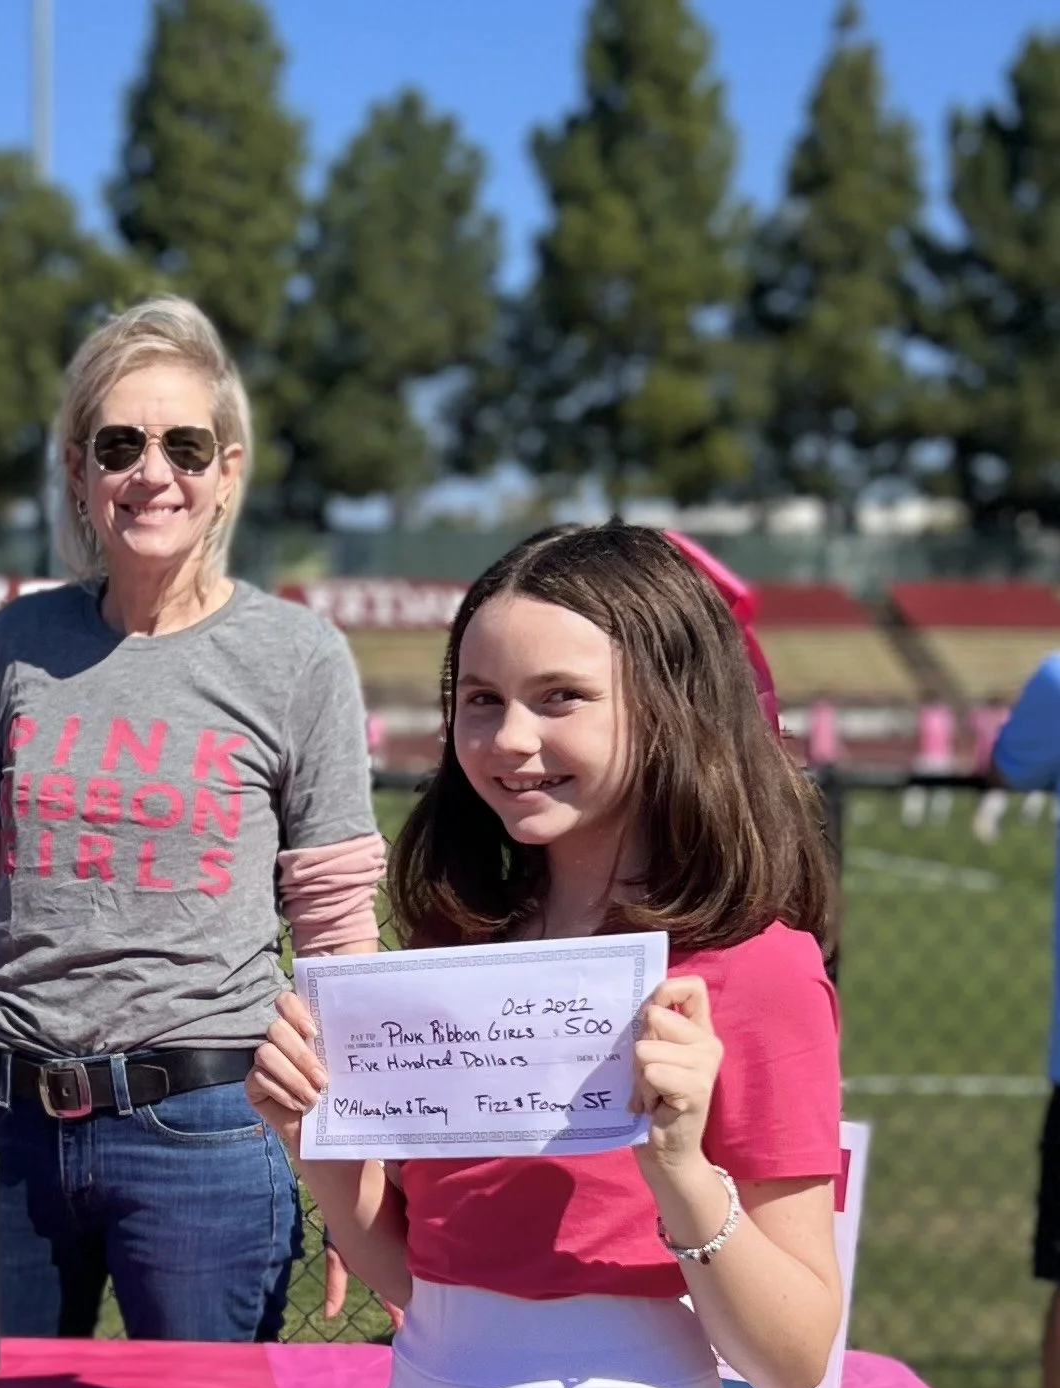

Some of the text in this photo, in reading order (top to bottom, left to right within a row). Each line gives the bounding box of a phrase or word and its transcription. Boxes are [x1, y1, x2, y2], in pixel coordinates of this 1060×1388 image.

[8, 714, 251, 788] PINK
[5, 829, 236, 897] IRLS
[501, 997, 594, 1016] Oct 2022
[429, 1018, 480, 1044] Ribbon
[564, 1016, 612, 1035] 500
[347, 1049, 529, 1073] Five Hundred Dollars
[474, 1094, 512, 1113] Fizz
[581, 1091, 612, 1110] SF
